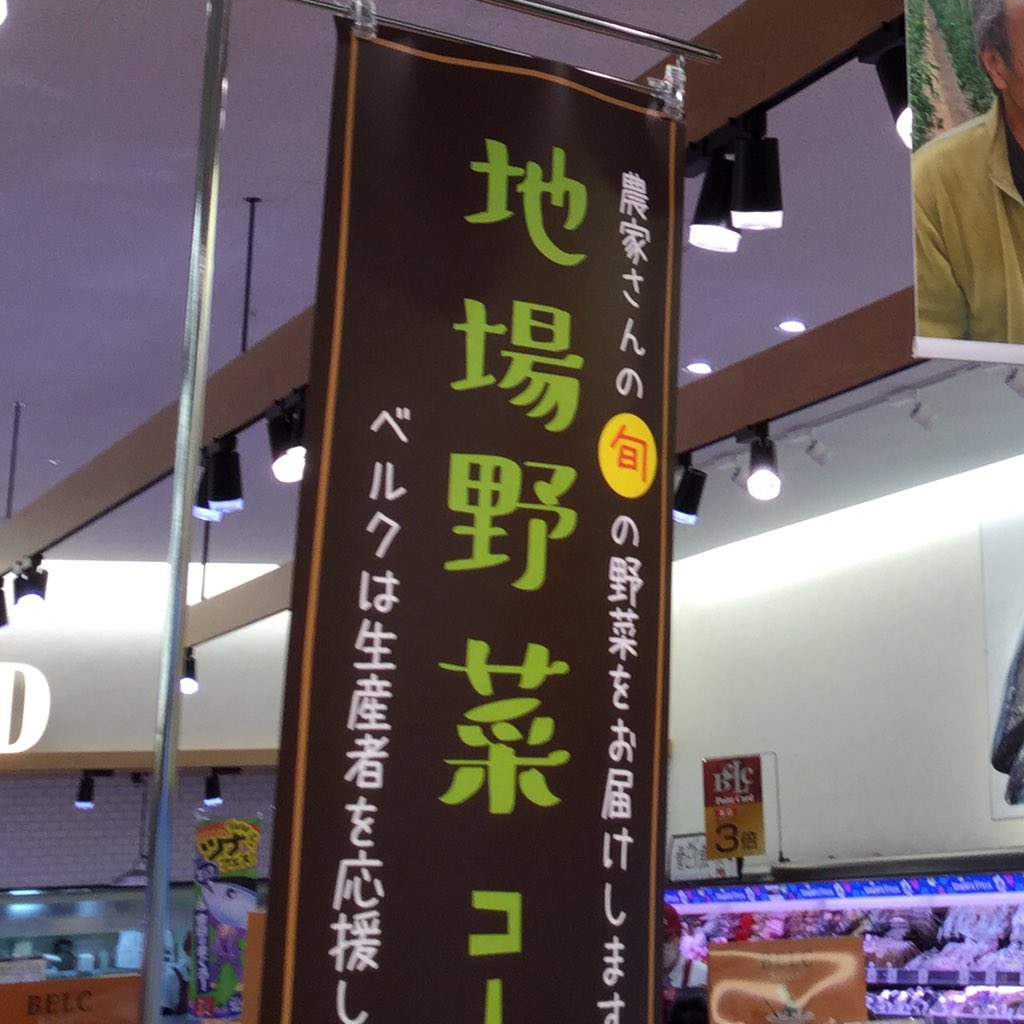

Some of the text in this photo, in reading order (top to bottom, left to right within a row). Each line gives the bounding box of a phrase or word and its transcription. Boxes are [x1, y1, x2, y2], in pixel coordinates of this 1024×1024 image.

[328, 406, 412, 1024] ベルクは生産者を応援し
